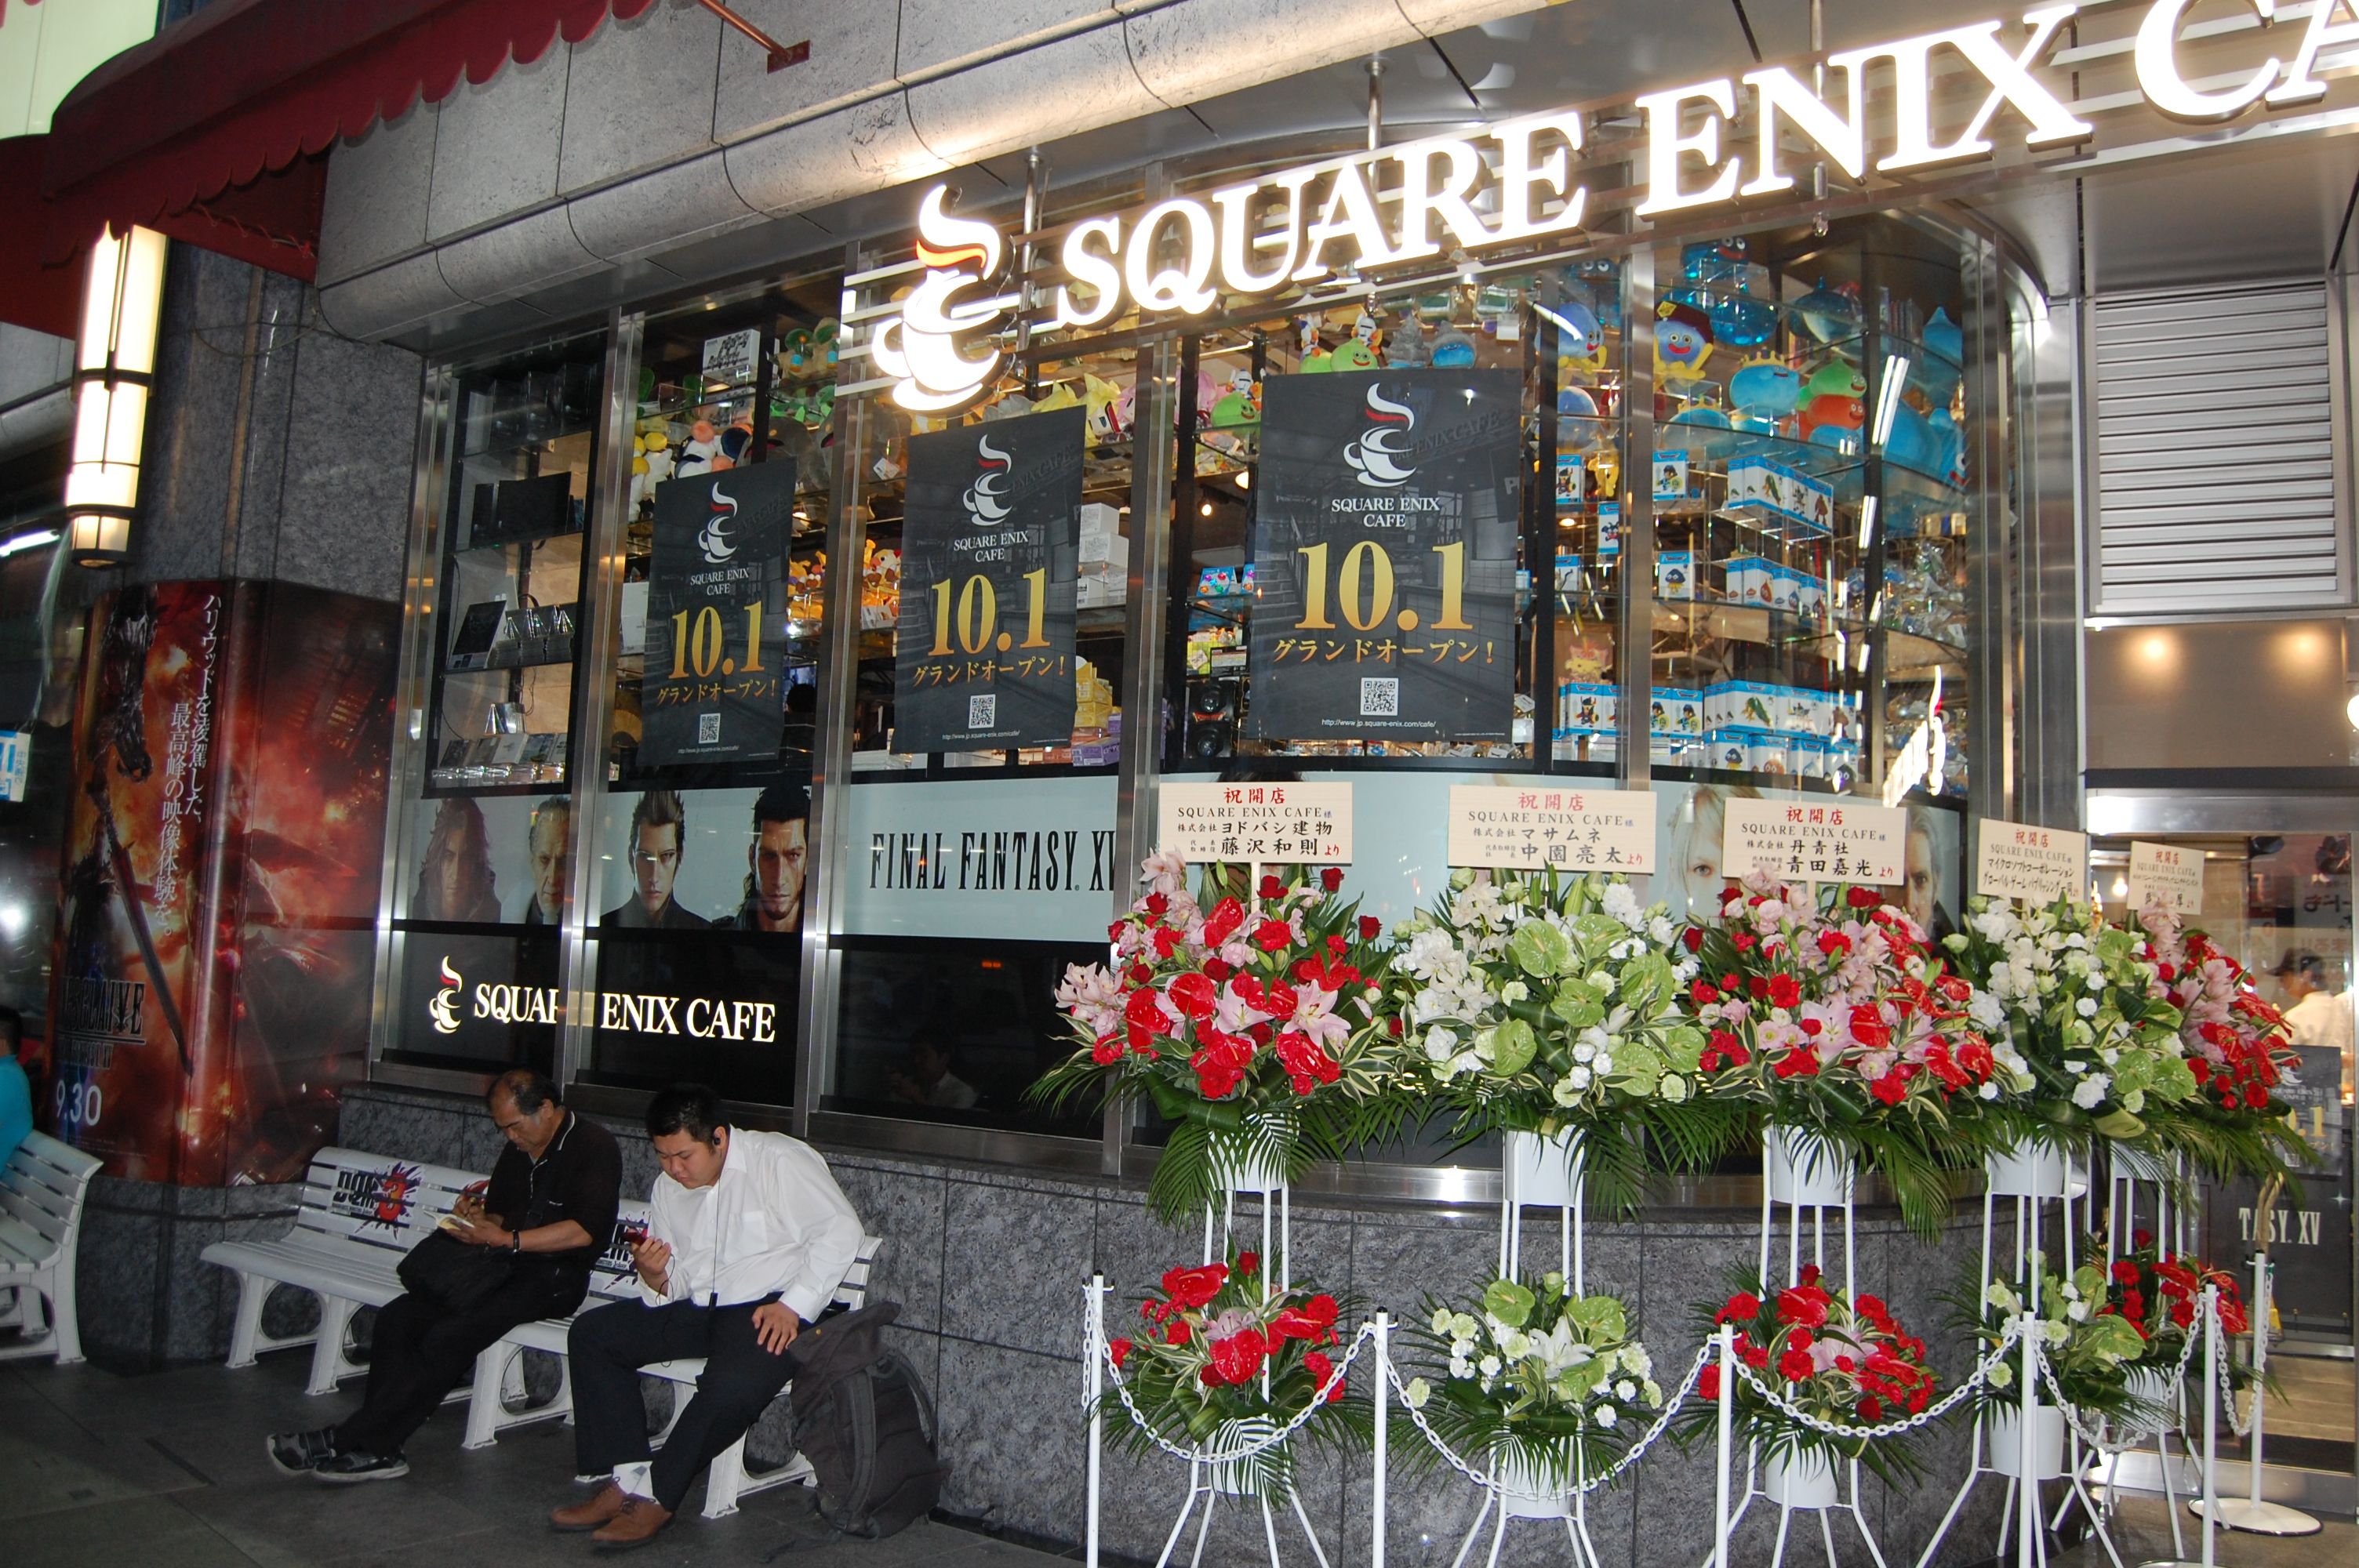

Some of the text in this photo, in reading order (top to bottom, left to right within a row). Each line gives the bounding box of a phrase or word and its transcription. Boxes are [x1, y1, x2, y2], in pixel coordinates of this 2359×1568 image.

[1055, 111, 1586, 325] SQUARE
[1634, 5, 2094, 216] ENIX
[1331, 497, 1394, 514] SQUARE
[1400, 496, 1440, 512] ENIX
[1364, 514, 1406, 528] CAFE
[954, 535, 997, 551] SQUARE
[1001, 531, 1028, 546] ENIX
[975, 548, 1005, 562] CAFE
[690, 567, 750, 586] SQUARE ENIX
[1294, 540, 1473, 631] 10.1
[707, 583, 730, 596] CAFE
[927, 568, 1050, 657] 10.1
[668, 600, 765, 680] 10.1
[1223, 787, 1286, 804] 祝開店
[1518, 793, 1584, 811] 祝開店
[1178, 807, 1235, 818] SQUARE
[1243, 807, 1277, 817] ENIX
[1285, 807, 1321, 817] CAFE
[1468, 811, 1530, 823] SQUARE
[1538, 813, 1575, 824] ENIX
[1583, 815, 1623, 826] CAFE
[1787, 806, 1844, 825] 祝開店
[1178, 820, 1332, 836] 株式会社 ヨドバシ建物
[1473, 828, 1601, 844] 株式会社 マサムネ
[1741, 823, 1796, 835] SQUARE
[1803, 826, 1834, 837] ENIX
[1842, 828, 1877, 840] CAFE
[1221, 837, 1318, 856] 藤沢和則
[1324, 844, 1340, 856] より
[1790, 839, 1849, 855] 丹青社
[1990, 843, 2021, 857] SQUARE
[2024, 848, 2043, 859] ENIX
[2046, 851, 2066, 862] CAFE
[870, 833, 947, 890] FINAL
[1627, 854, 1643, 866] より
[1787, 855, 1873, 877] 青田嘉光
[1879, 866, 1894, 878] より
[474, 983, 776, 1044] SQUA ENIX CAFE
[56, 1080, 102, 1126] 9.30
